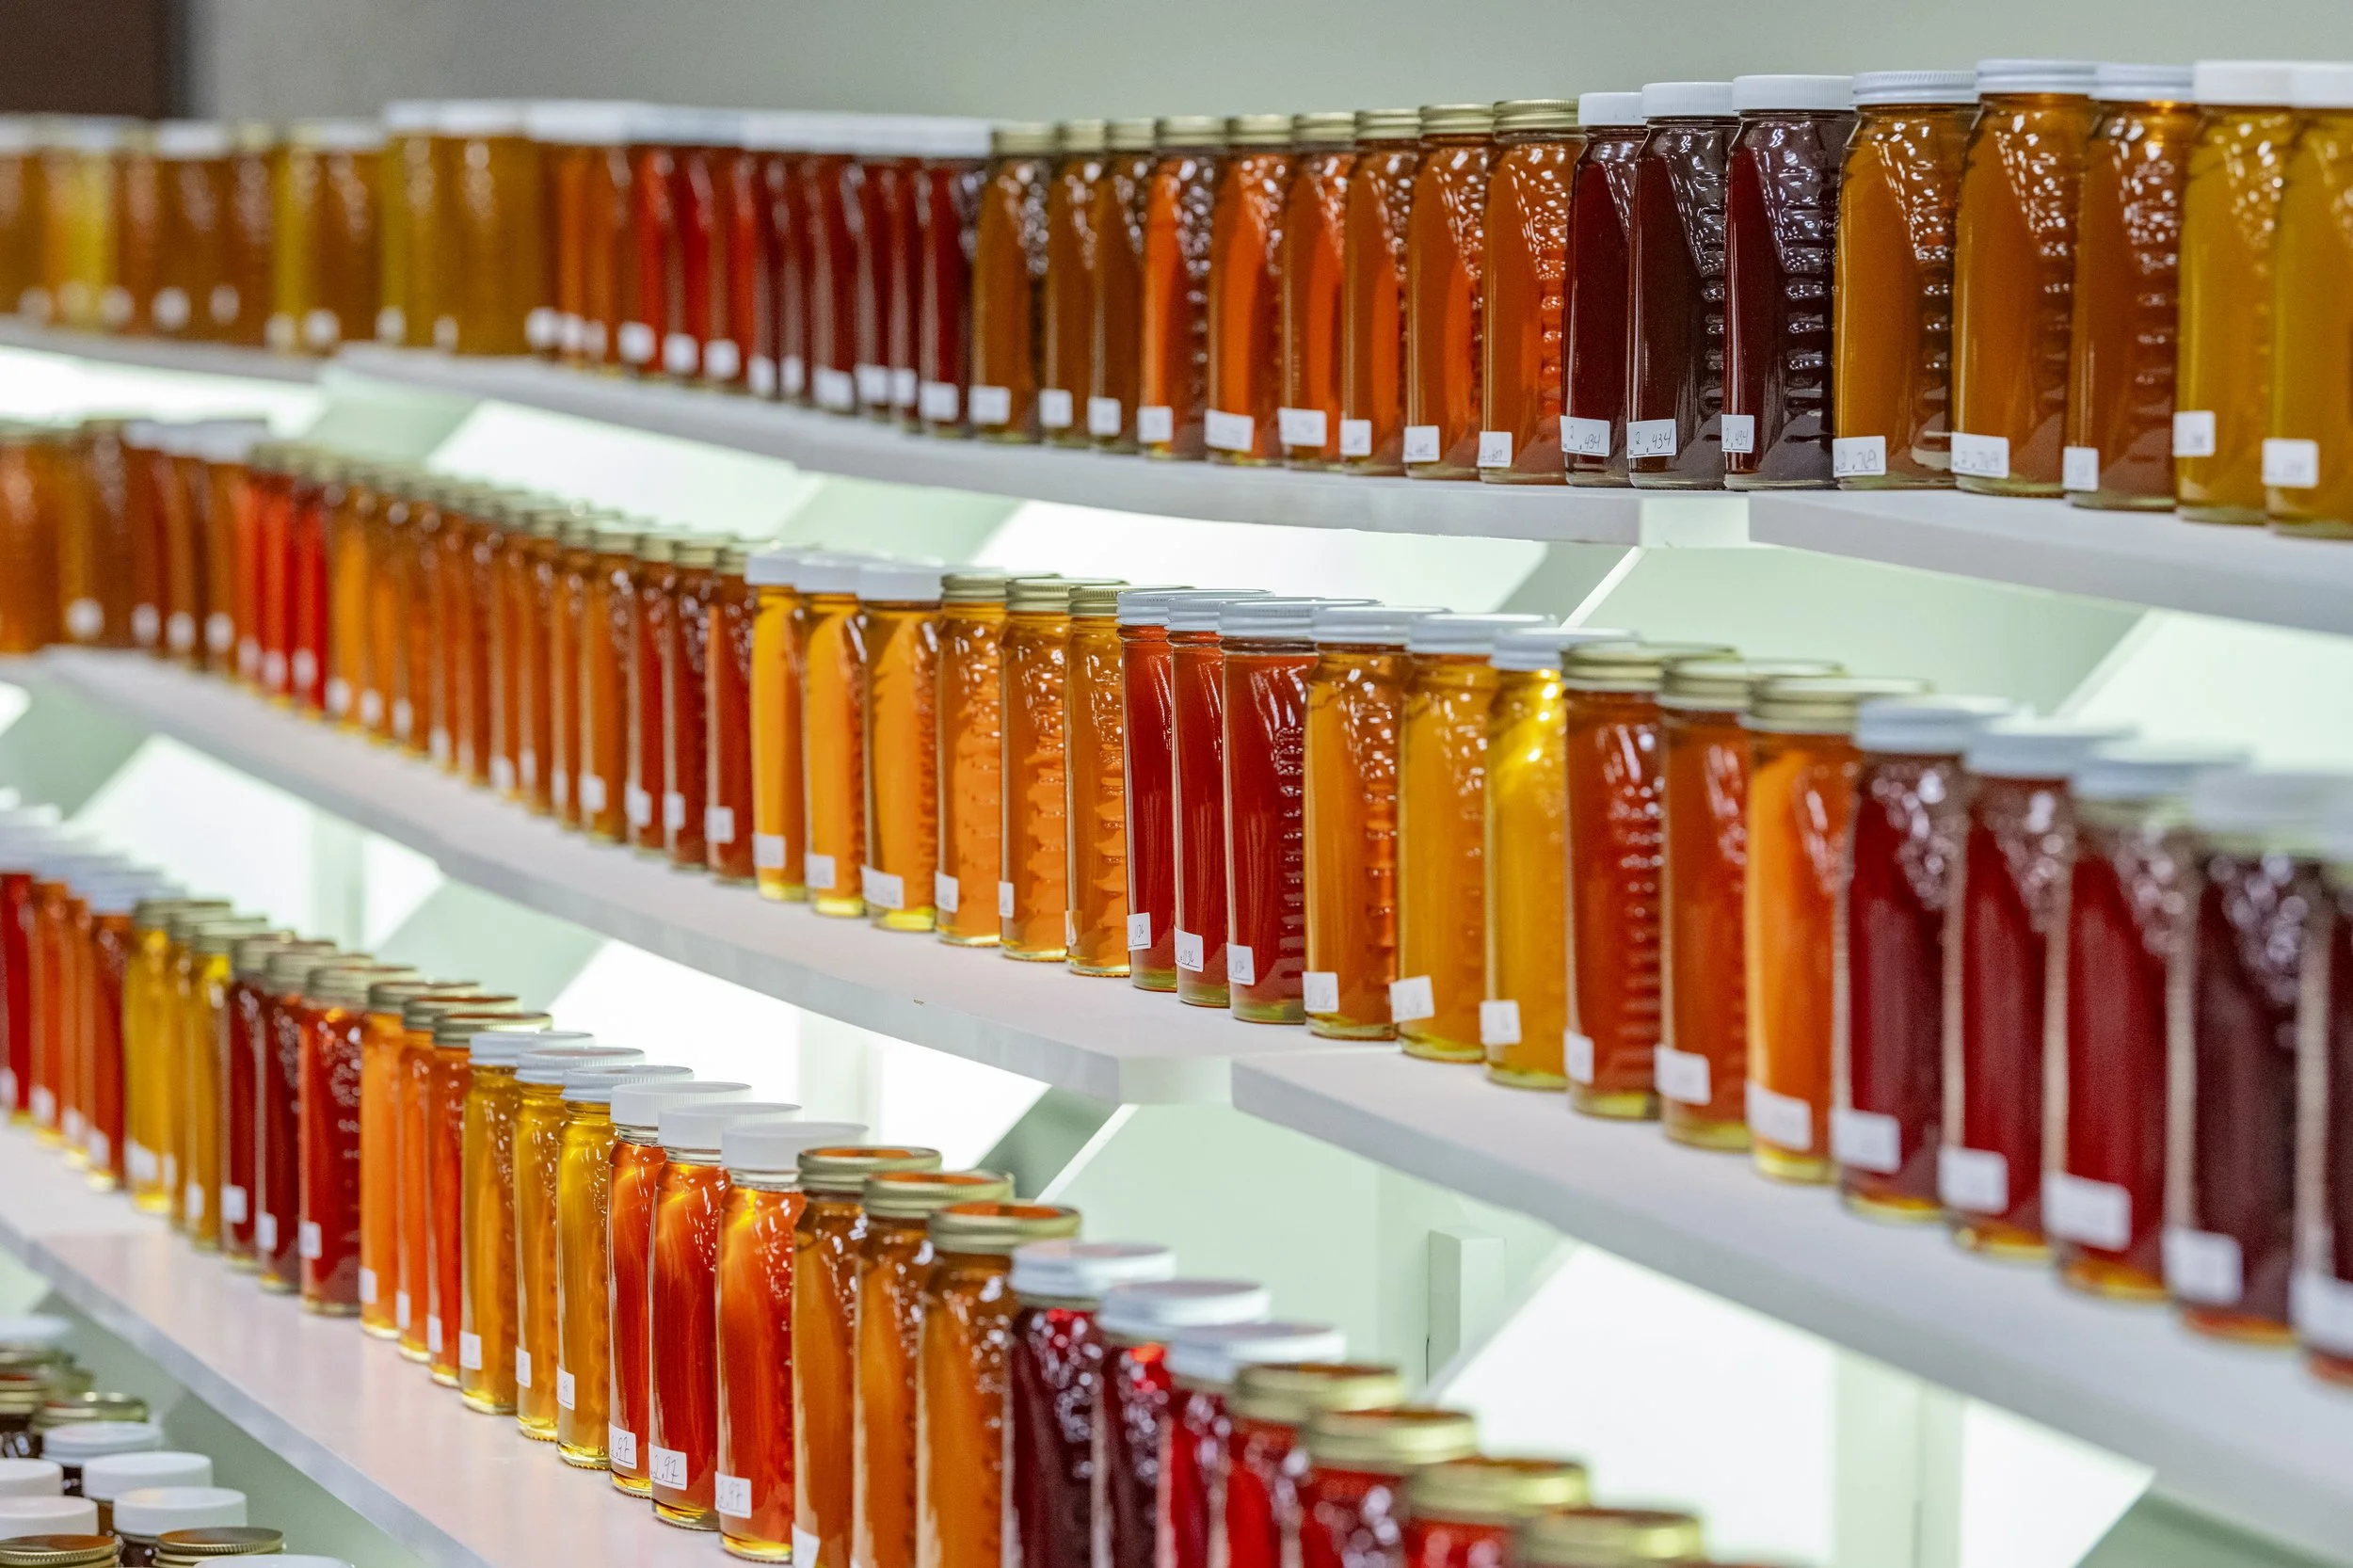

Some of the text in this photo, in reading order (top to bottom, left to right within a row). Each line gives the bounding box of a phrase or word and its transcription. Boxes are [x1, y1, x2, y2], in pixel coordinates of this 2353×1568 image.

[1584, 433, 1601, 450] 434
[1651, 428, 1673, 450] 434
[664, 1455, 679, 1483] 97
